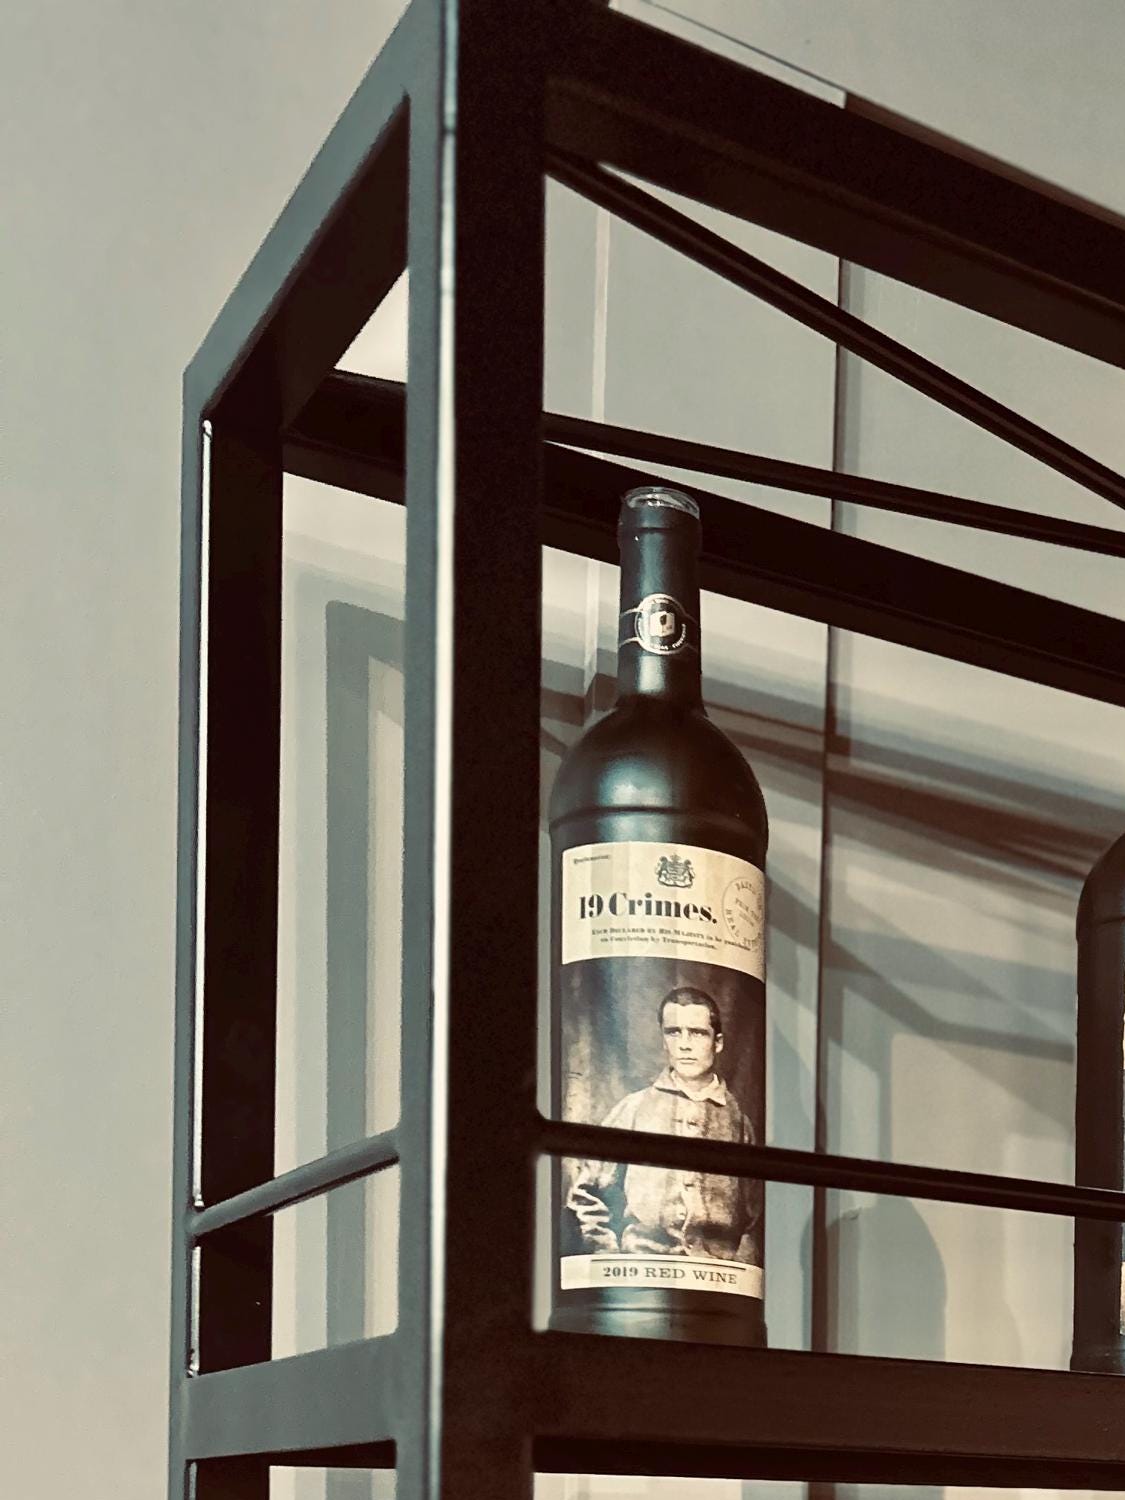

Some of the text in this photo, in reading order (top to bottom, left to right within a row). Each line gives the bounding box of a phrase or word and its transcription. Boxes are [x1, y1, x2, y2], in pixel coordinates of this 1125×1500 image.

[579, 893, 604, 920] 19
[608, 891, 718, 925] Crimes.
[603, 1266, 738, 1285] 2019 RED WINE
